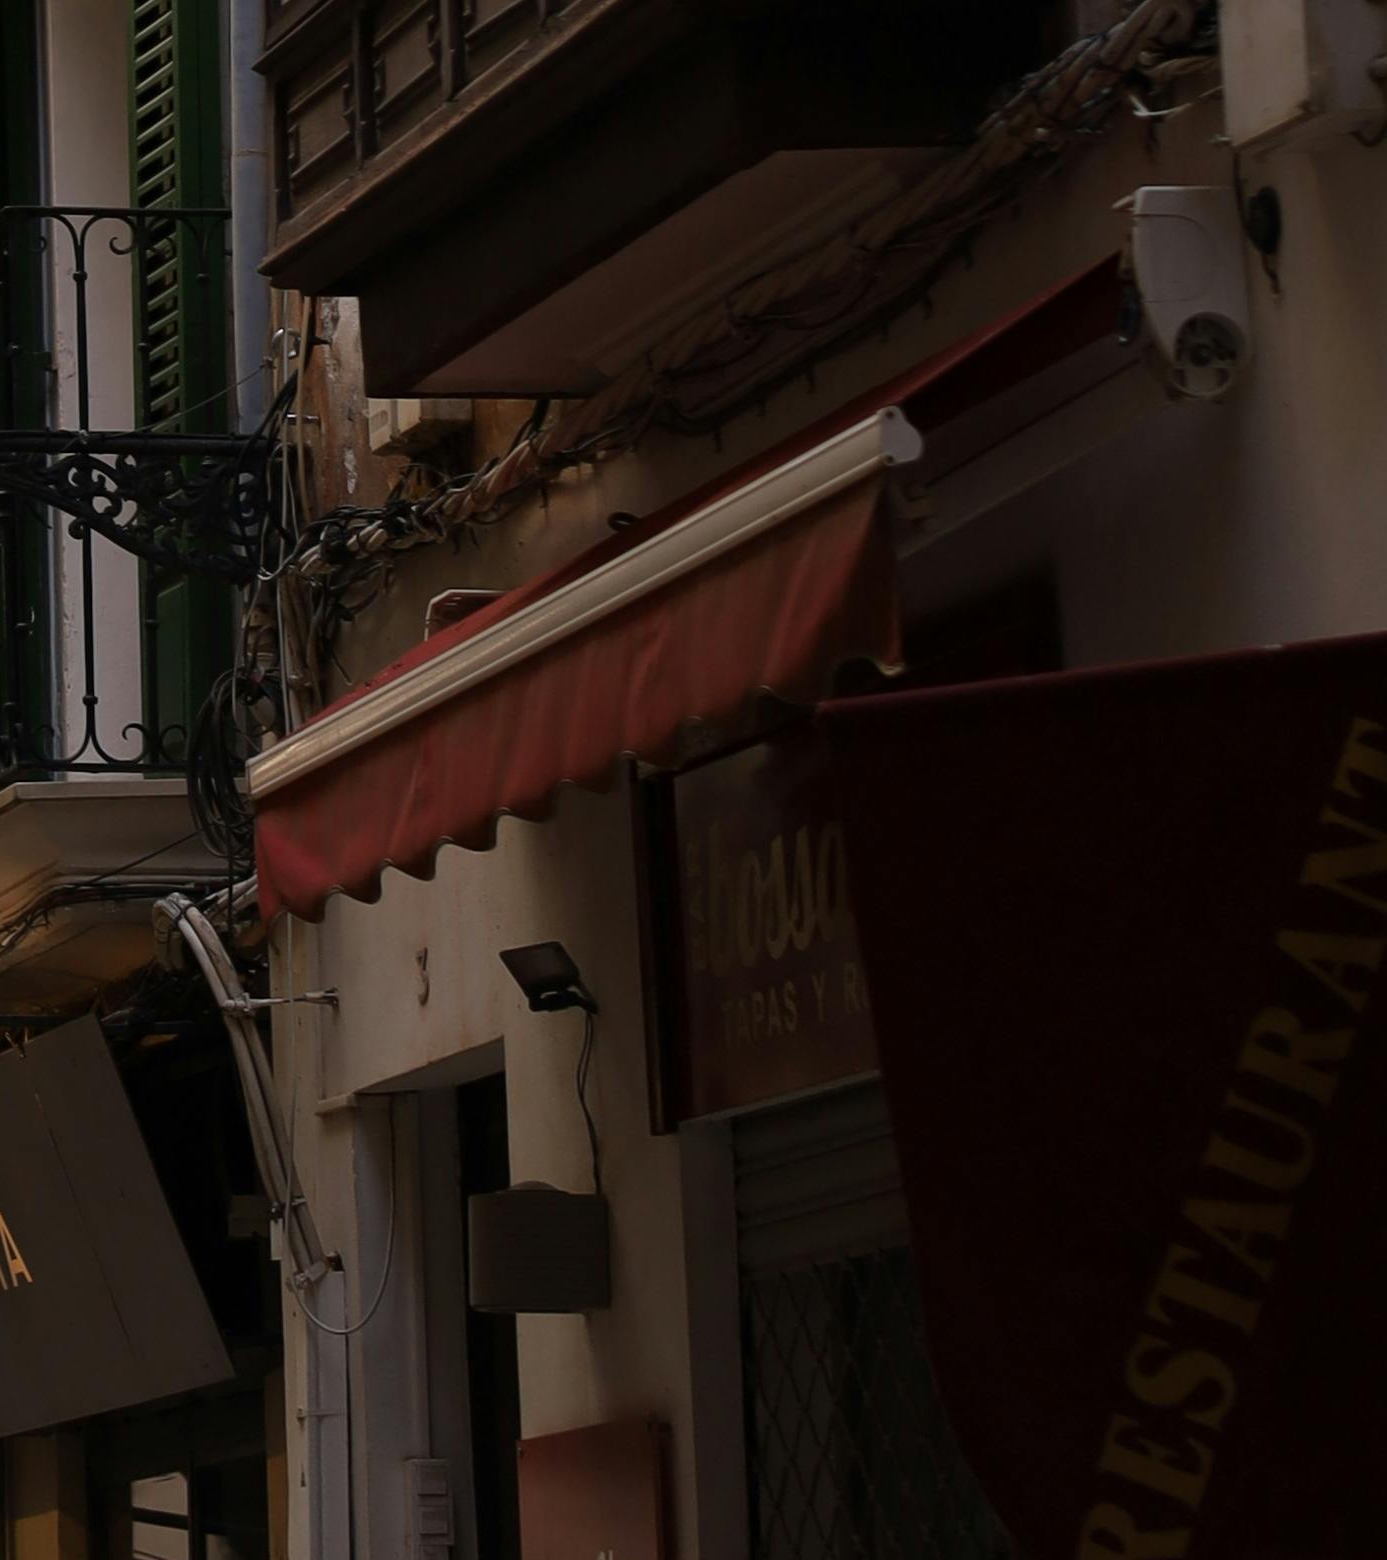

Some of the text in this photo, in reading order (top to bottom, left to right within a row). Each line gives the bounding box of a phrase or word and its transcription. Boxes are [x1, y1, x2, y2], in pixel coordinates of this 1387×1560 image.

[416, 946, 430, 1006] 3
[721, 977, 798, 1045] TAPAS
[810, 968, 828, 1024] Y
